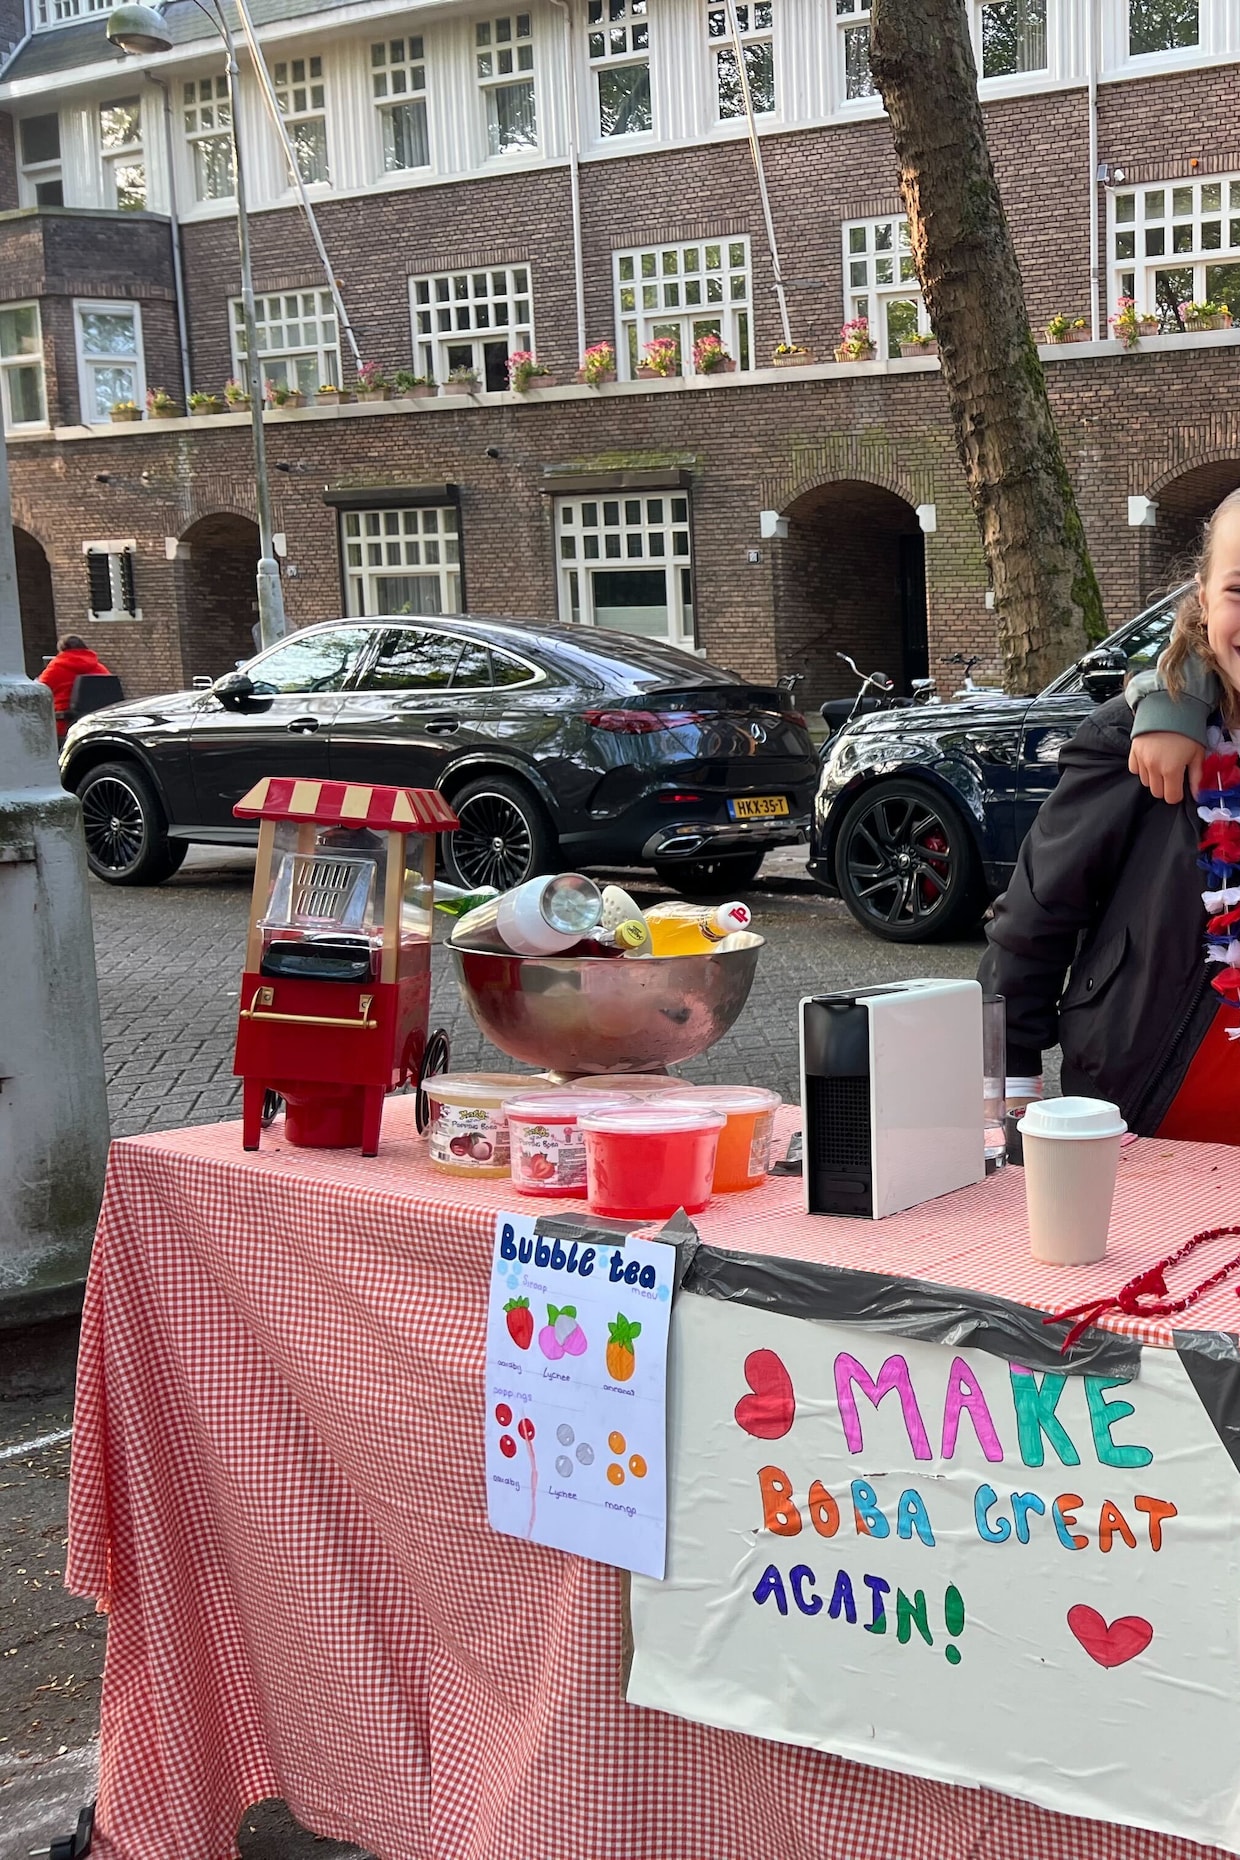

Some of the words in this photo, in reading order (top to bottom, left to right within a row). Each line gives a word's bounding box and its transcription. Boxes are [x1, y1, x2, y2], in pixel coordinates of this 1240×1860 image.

[738, 799, 785, 816] HKX-35-T
[500, 1223, 596, 1277] Bubble
[609, 1250, 657, 1289] tea
[834, 1352, 1154, 1469] MAKE
[549, 1485, 578, 1500] Lychee
[604, 1501, 637, 1517] mango
[757, 1465, 936, 1548] BOBA
